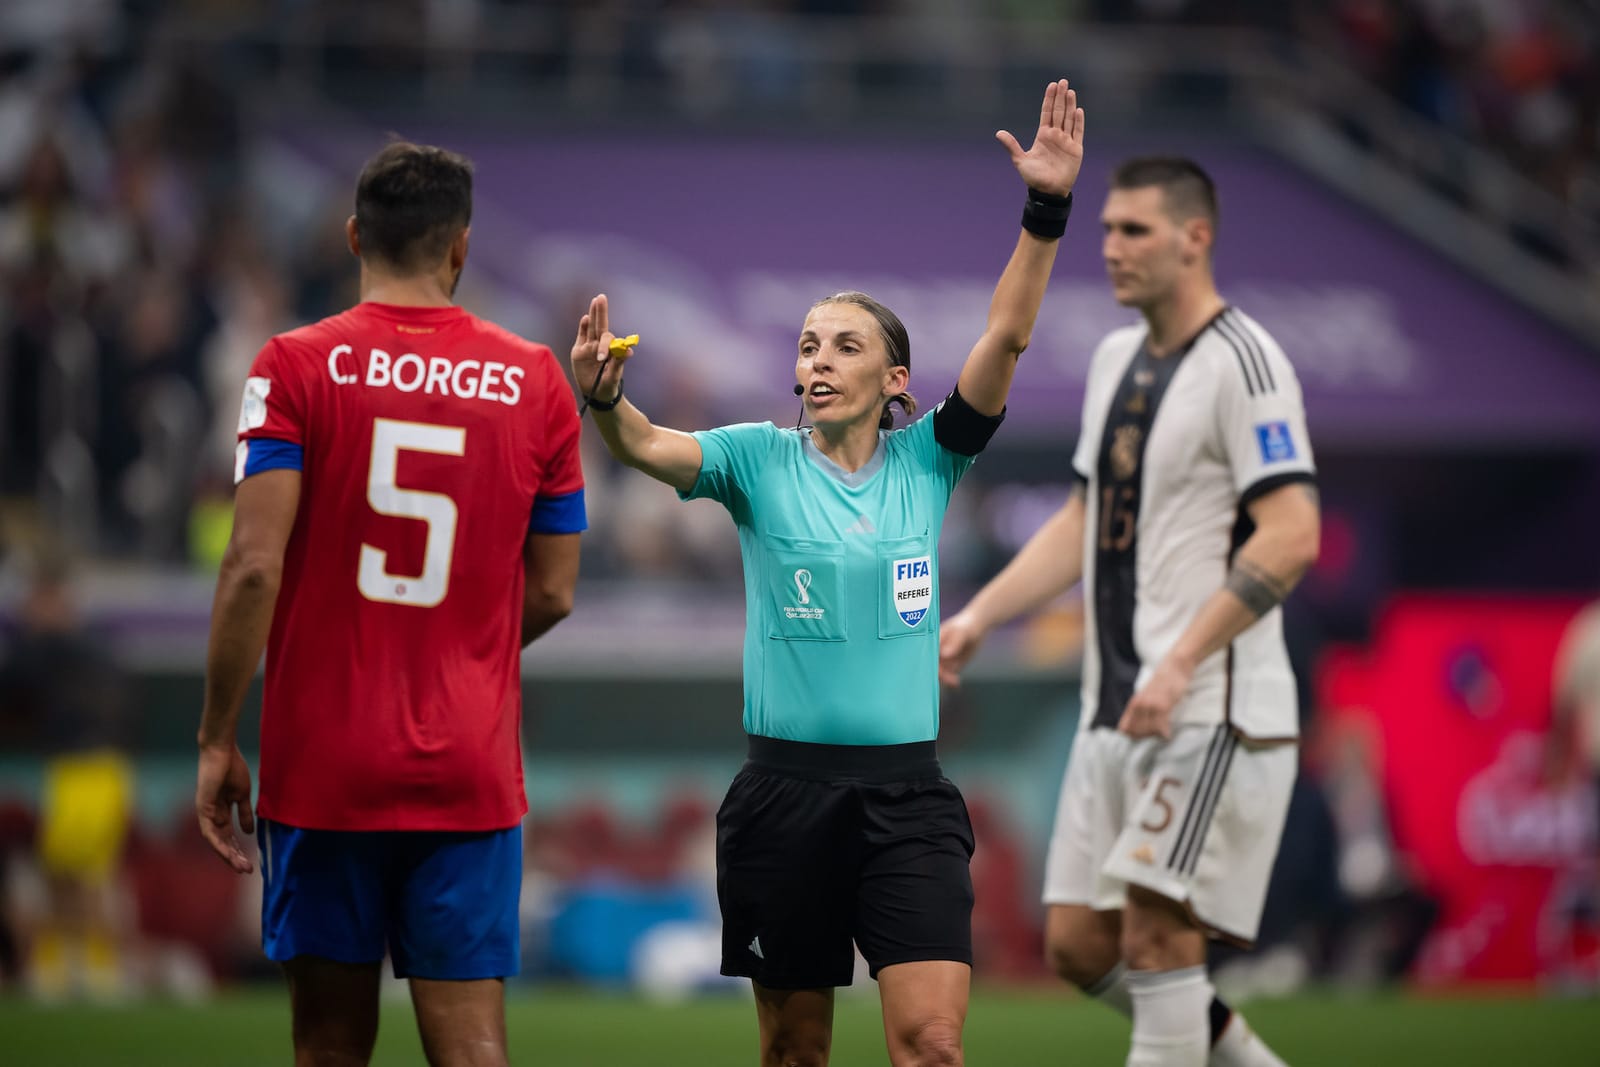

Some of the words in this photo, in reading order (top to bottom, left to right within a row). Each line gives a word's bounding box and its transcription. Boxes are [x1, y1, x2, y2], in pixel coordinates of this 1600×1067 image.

[328, 344, 358, 385] C.
[366, 349, 525, 405] BORGES
[357, 417, 467, 608] 5
[897, 561, 929, 580] FIFA
[897, 587, 929, 600] REFEREE
[906, 611, 921, 620] 2022
